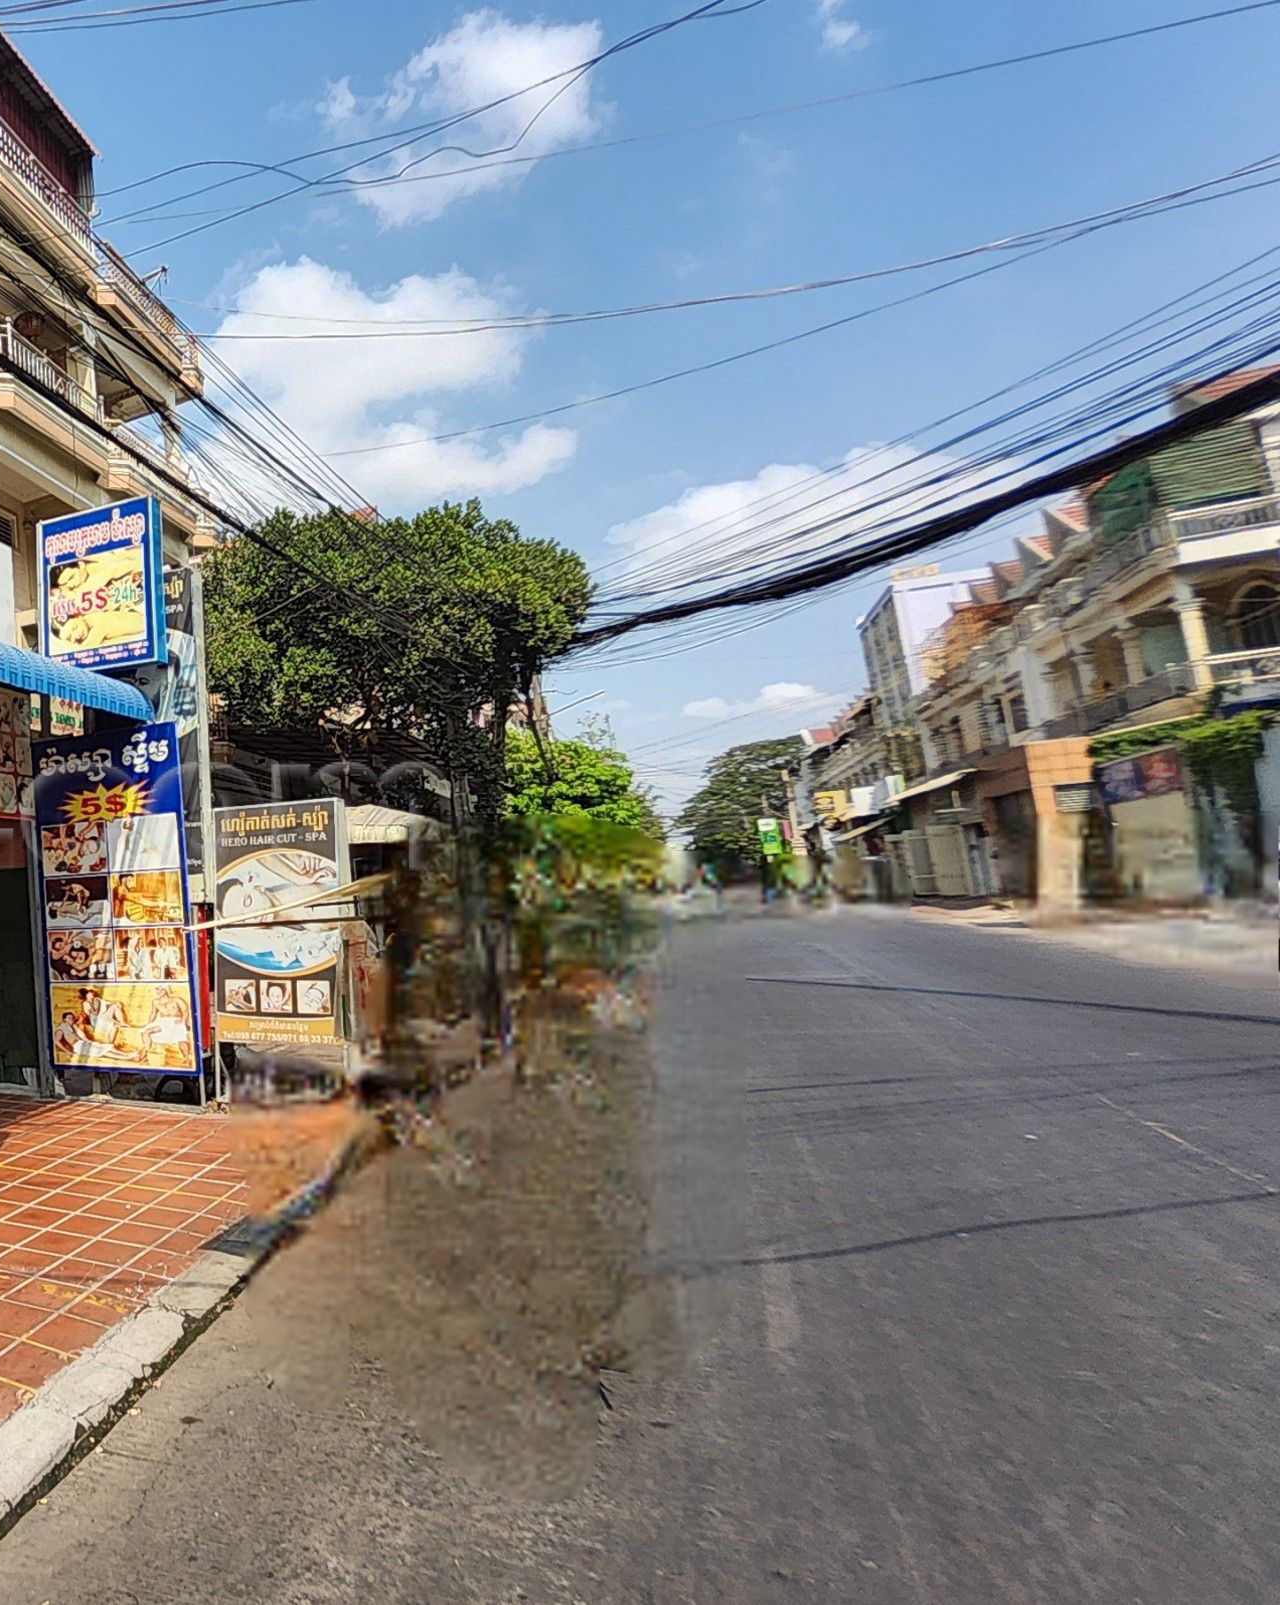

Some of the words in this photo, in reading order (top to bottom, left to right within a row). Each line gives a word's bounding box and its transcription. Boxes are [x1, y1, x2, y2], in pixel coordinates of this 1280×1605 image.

[114, 585, 137, 604] 24h
[81, 793, 127, 816] 5$
[221, 837, 248, 847] HERO
[250, 835, 275, 846] HAIR
[276, 833, 297, 843] CUT
[305, 831, 328, 842] SPA
